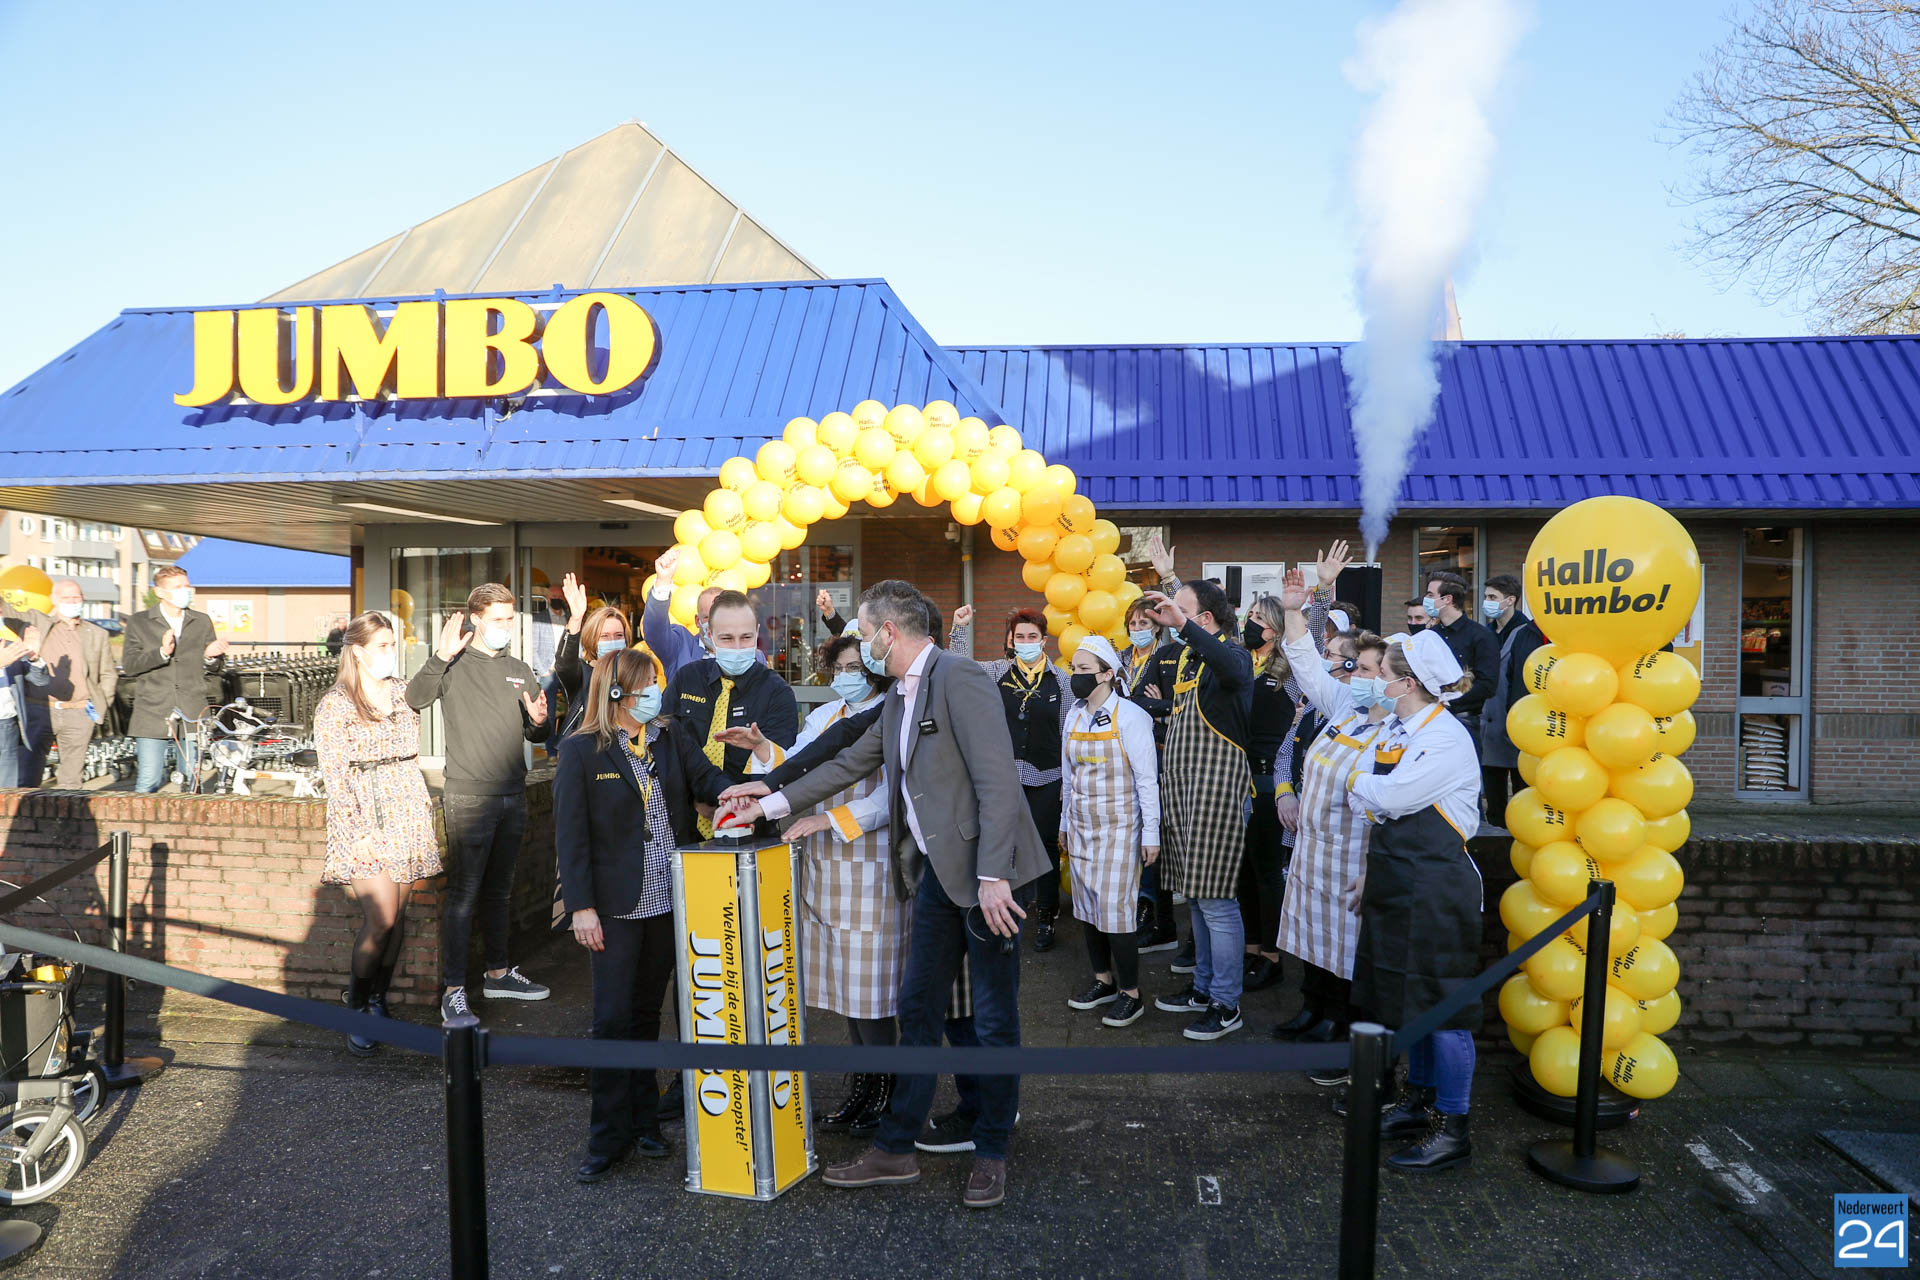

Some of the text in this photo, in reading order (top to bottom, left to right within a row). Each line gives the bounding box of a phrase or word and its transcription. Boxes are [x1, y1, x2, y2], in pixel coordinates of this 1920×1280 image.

[173, 292, 660, 407] JUMBO
[1537, 548, 1634, 587] Hallo
[1544, 584, 1671, 615] Jumbo!
[1534, 663, 1544, 690] Hallo
[680, 692, 706, 704] JUMBO
[1546, 710, 1557, 738] Hallo
[1557, 711, 1567, 739] Jumb
[595, 773, 621, 781] JUMBO
[722, 902, 736, 966] 'Welkom
[783, 890, 793, 953] 'Welkom
[785, 956, 795, 974] bij
[724, 969, 739, 989] bij
[788, 977, 795, 995] de
[727, 991, 740, 1010] de
[1612, 1052, 1627, 1087] Jumbo!
[1623, 1057, 1637, 1084] Hallo
